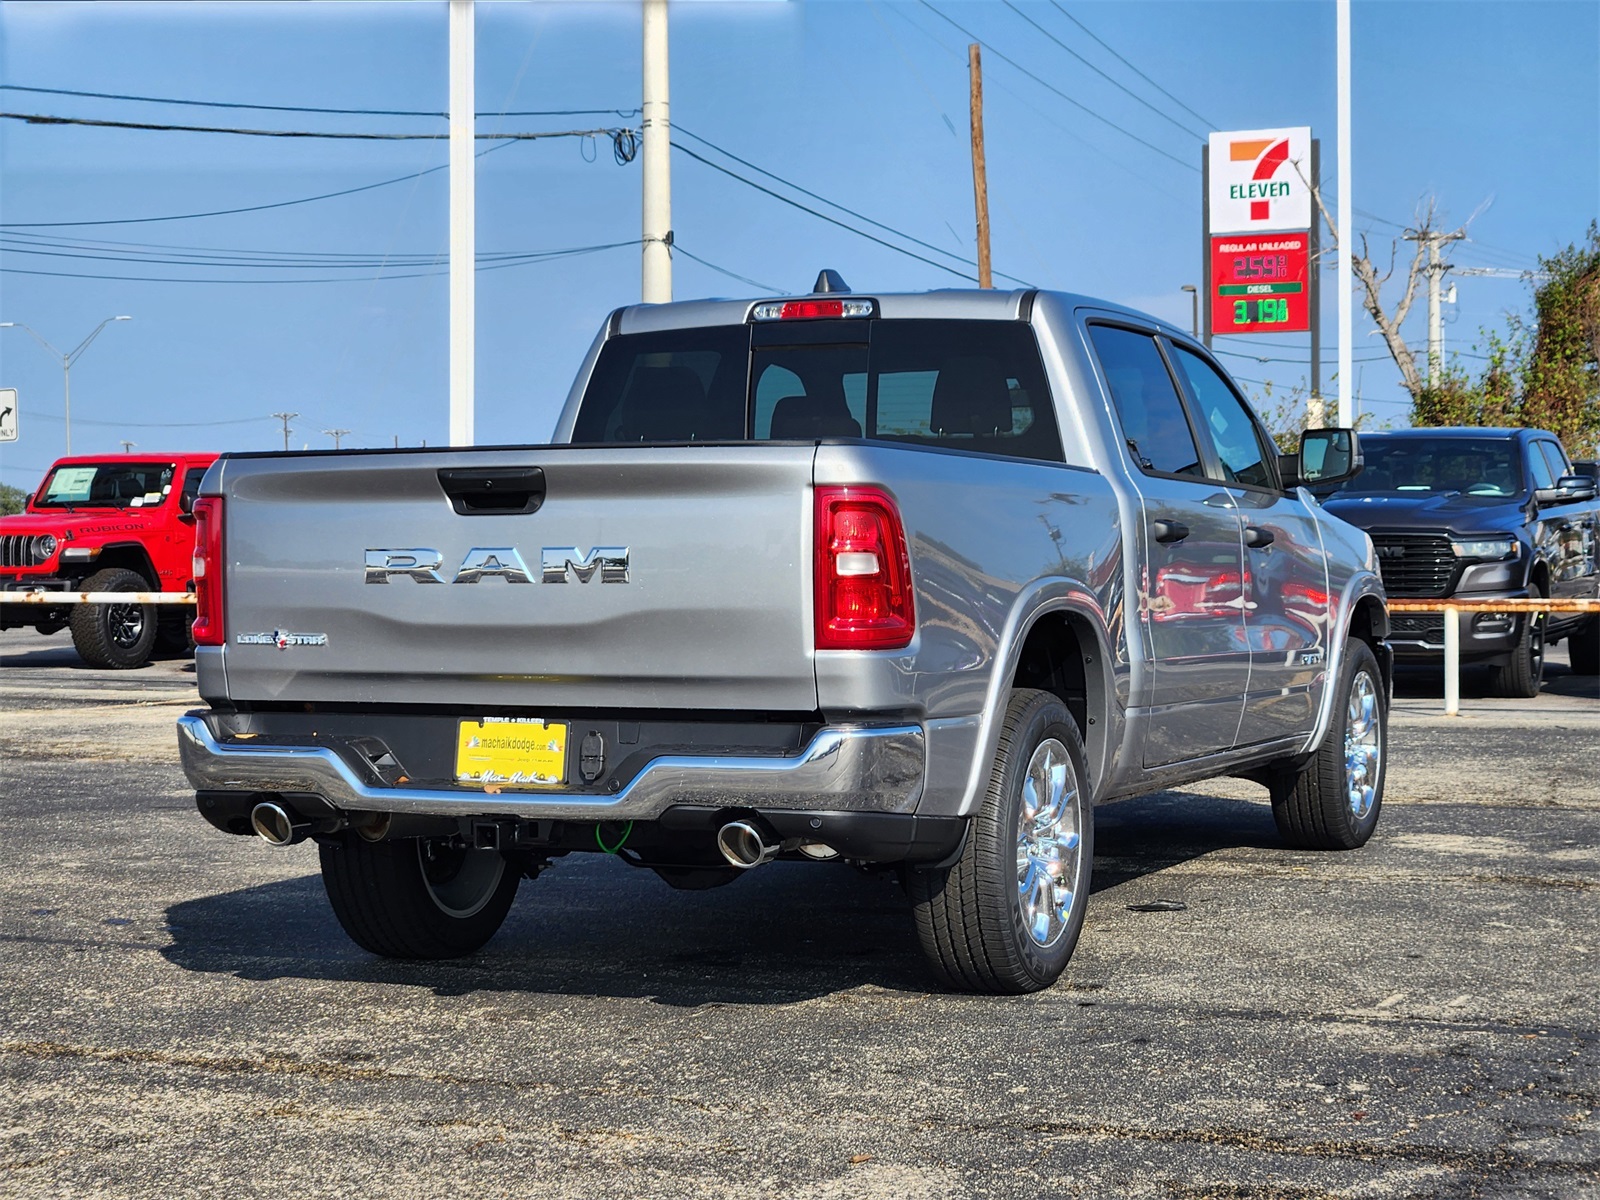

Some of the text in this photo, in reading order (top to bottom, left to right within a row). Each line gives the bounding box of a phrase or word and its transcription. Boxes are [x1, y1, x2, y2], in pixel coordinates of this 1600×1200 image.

[1230, 138, 1289, 220] 7
[1219, 241, 1301, 253] REGULAR UNLEADED
[1247, 285, 1273, 294] DIESEL
[0, 428, 15, 437] NLY
[79, 523, 145, 534] RUBICON
[364, 546, 631, 585] RAM
[236, 634, 327, 646] LONE STAR
[481, 736, 547, 753] machaikdodge.com
